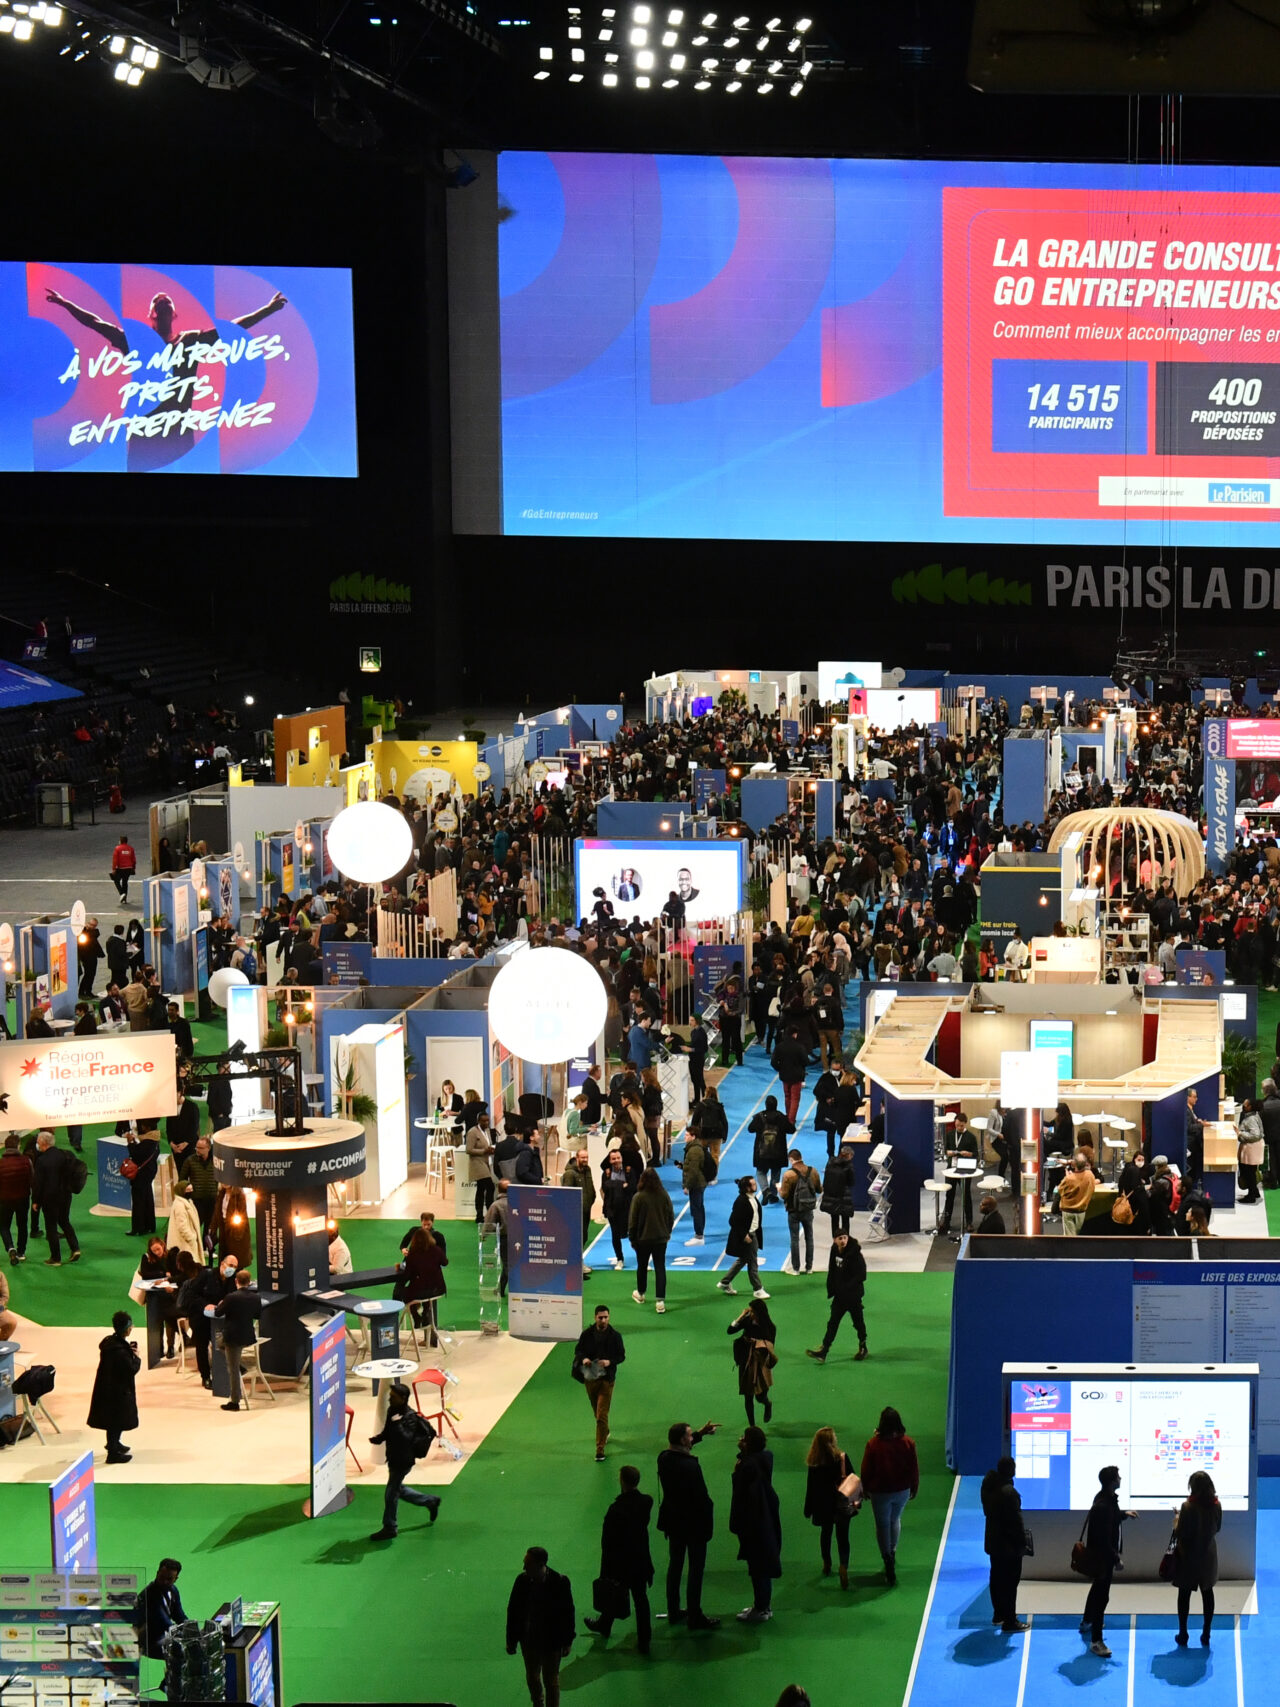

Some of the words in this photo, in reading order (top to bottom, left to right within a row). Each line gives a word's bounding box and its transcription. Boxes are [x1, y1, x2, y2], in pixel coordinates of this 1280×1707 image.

[992, 238, 1028, 267] LA
[1038, 239, 1157, 269] GRANDE
[993, 276, 1035, 306] GO
[993, 321, 1070, 340] Comment
[1075, 323, 1124, 341] mieux
[1127, 326, 1235, 345] accompagner
[1238, 325, 1261, 342] les
[58, 348, 80, 384] À
[88, 346, 143, 379] VOS
[147, 335, 290, 372] MARQUES,
[118, 372, 220, 409] PRÊTS,
[1027, 383, 1060, 411] 14
[1067, 384, 1120, 412] 515
[1208, 378, 1262, 406] 400
[69, 399, 276, 447] ENTREPRENEZ
[1028, 416, 1114, 430] PARTICIPANTS
[1190, 410, 1276, 425] PROPOSITIONS
[1203, 425, 1264, 441] DÉPOSÉES
[522, 508, 599, 520] #GoEntrepreneurs
[1046, 565, 1171, 609] PARIS
[1182, 567, 1232, 609] LA
[330, 603, 350, 613] PARIS
[351, 603, 359, 613] LA
[361, 603, 391, 613] DEFENSE
[1214, 763, 1230, 816] STAGE
[1213, 817, 1228, 862] MAIN
[49, 1050, 104, 1065] Région
[234, 1158, 293, 1169] Entrepreneur
[1200, 1273, 1225, 1282] LISTE
[1227, 1273, 1245, 1282] DES
